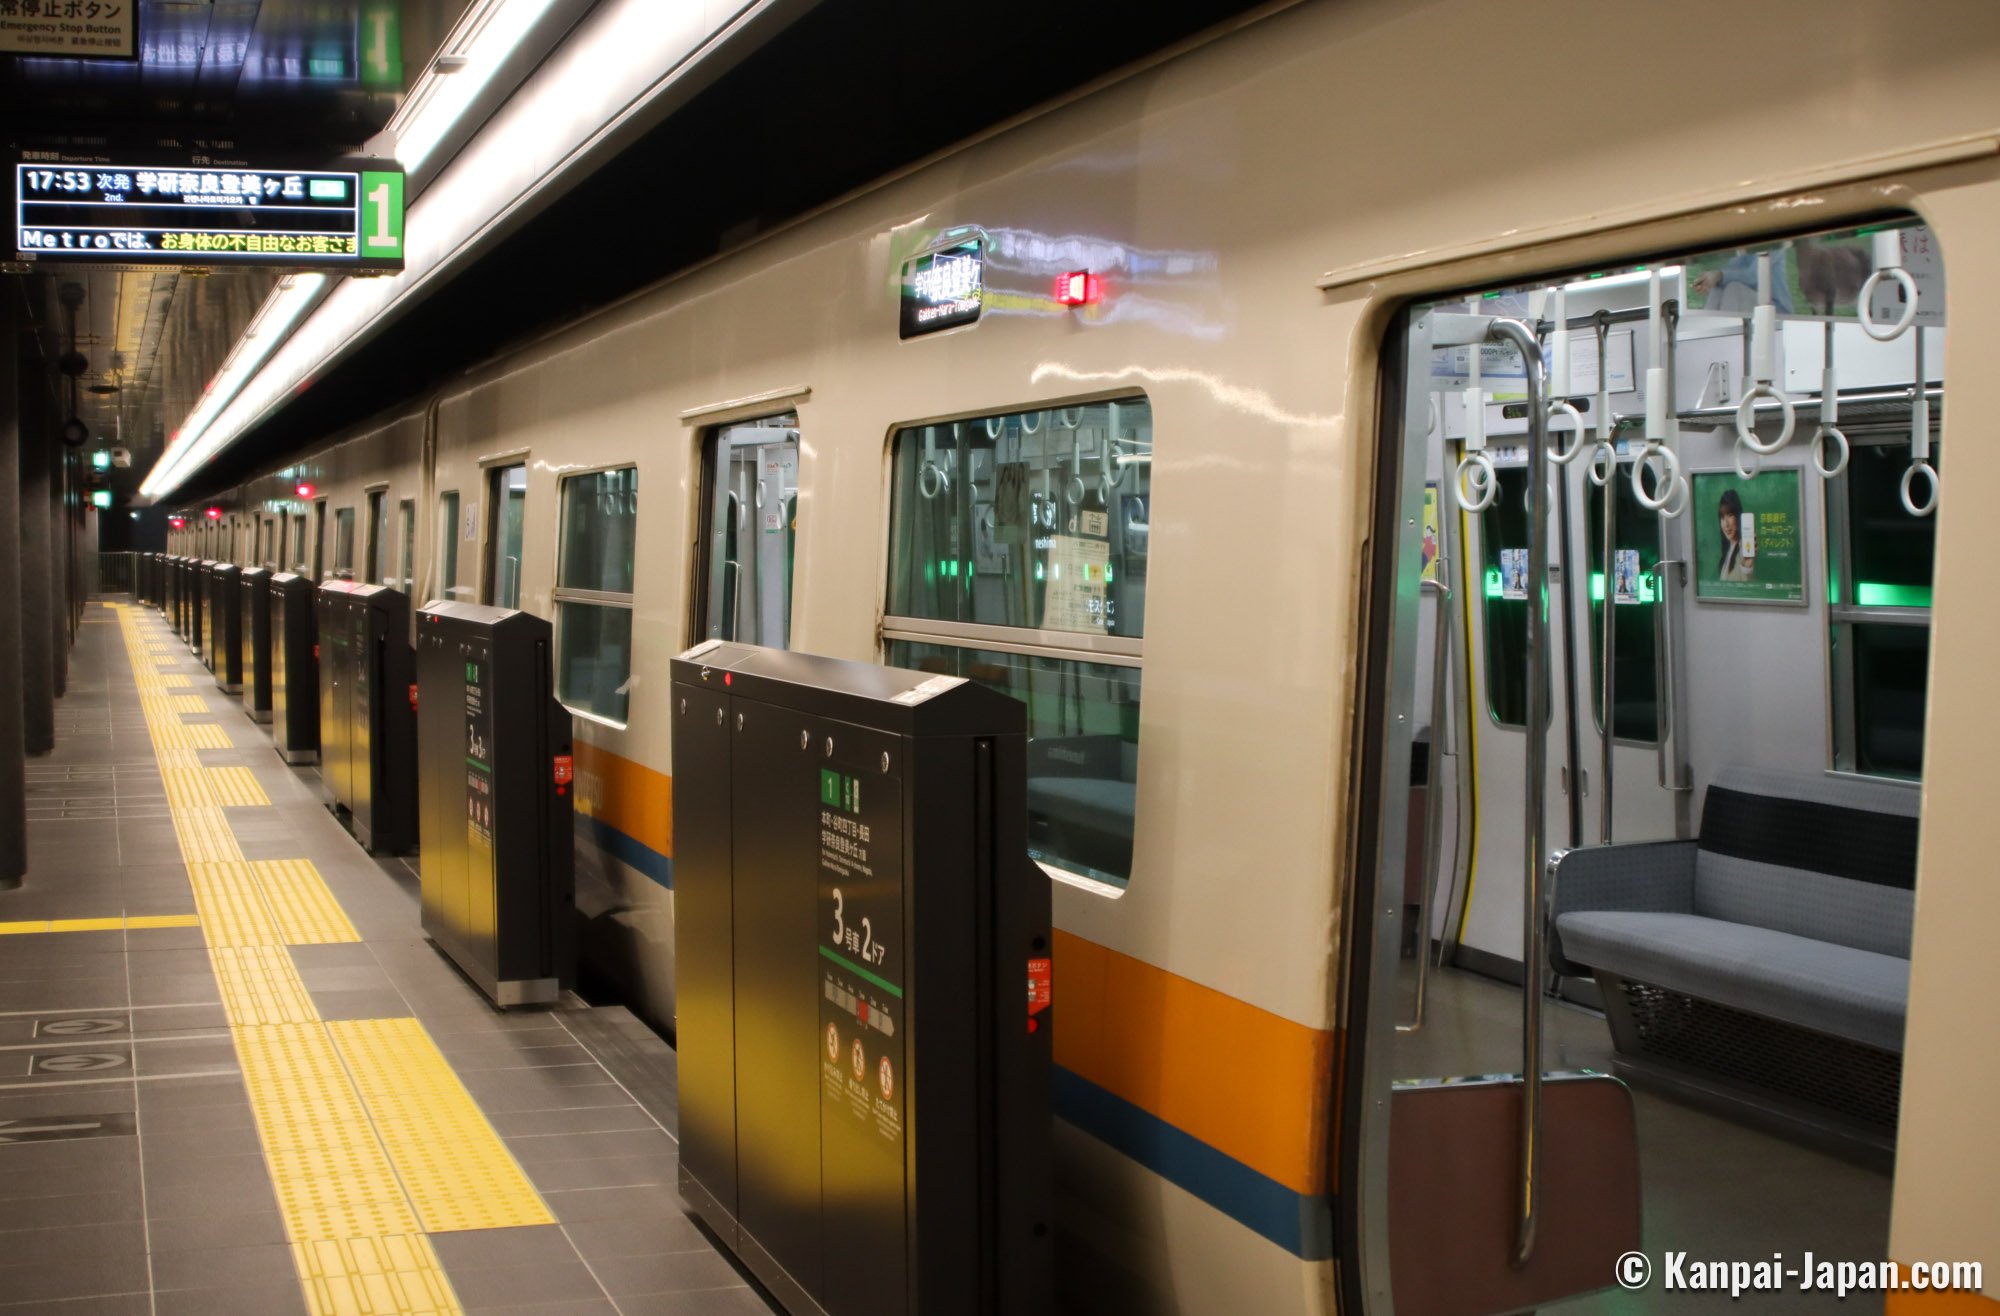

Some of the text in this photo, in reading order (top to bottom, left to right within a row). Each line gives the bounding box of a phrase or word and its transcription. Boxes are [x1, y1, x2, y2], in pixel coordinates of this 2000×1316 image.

[0, 0, 121, 19] 常停止ボタン
[0, 21, 121, 34] Emergency Stop Button
[27, 170, 91, 192] 17:53
[96, 173, 131, 191] 次発
[368, 184, 398, 247] 1
[828, 777, 833, 799] 1
